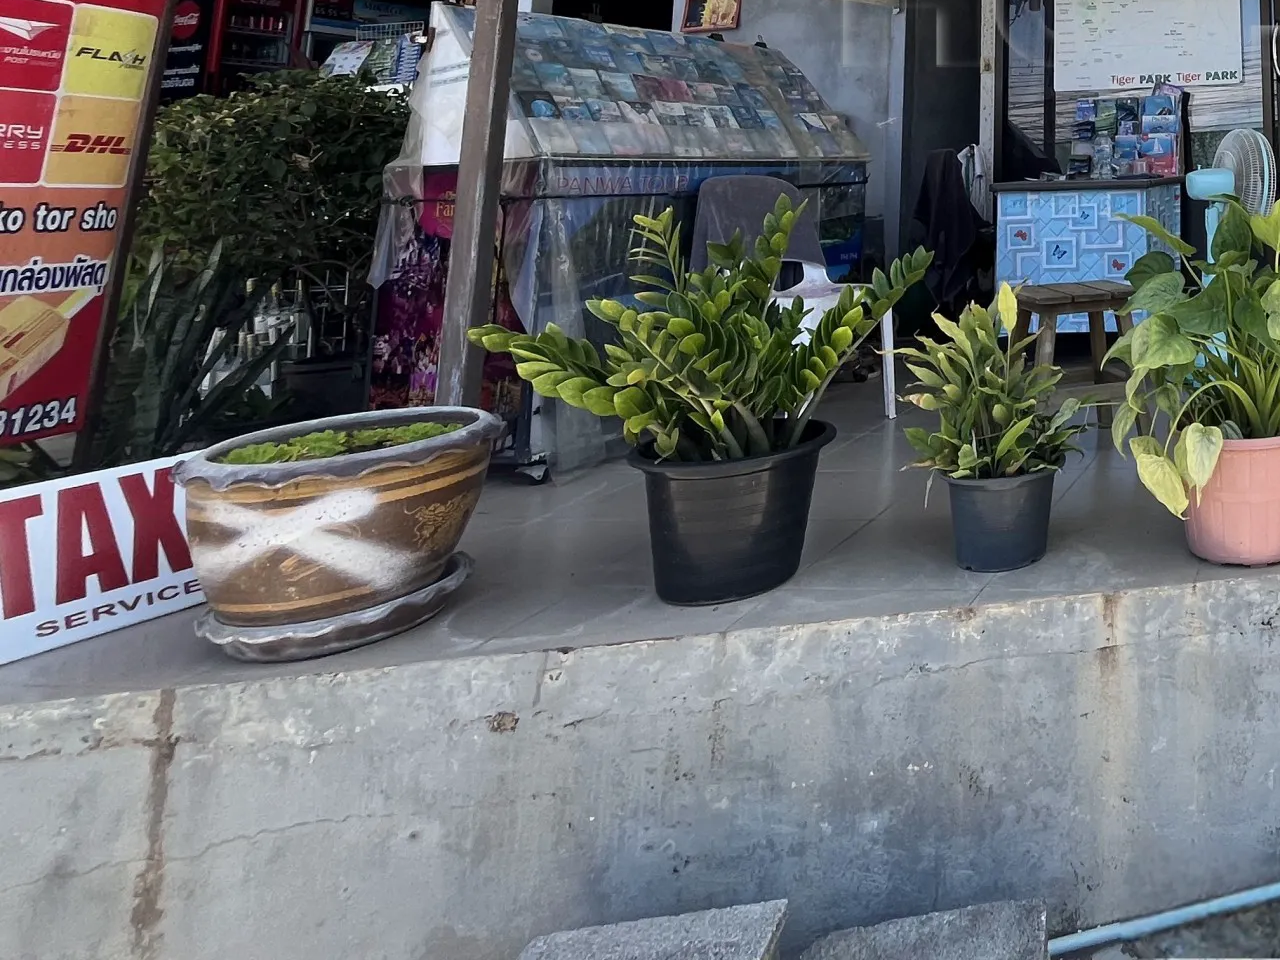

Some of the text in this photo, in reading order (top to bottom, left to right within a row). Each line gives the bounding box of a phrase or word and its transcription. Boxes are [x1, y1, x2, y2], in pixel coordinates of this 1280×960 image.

[1110, 75, 1135, 85] Tiger
[1176, 72, 1201, 83] Tiger
[1205, 70, 1237, 81] PARK
[64, 134, 129, 155] DHL
[36, 204, 75, 231] tor
[81, 203, 117, 229] sho
[0, 256, 107, 293] กล่องพัสดุ
[35, 578, 202, 637] SERVICE
